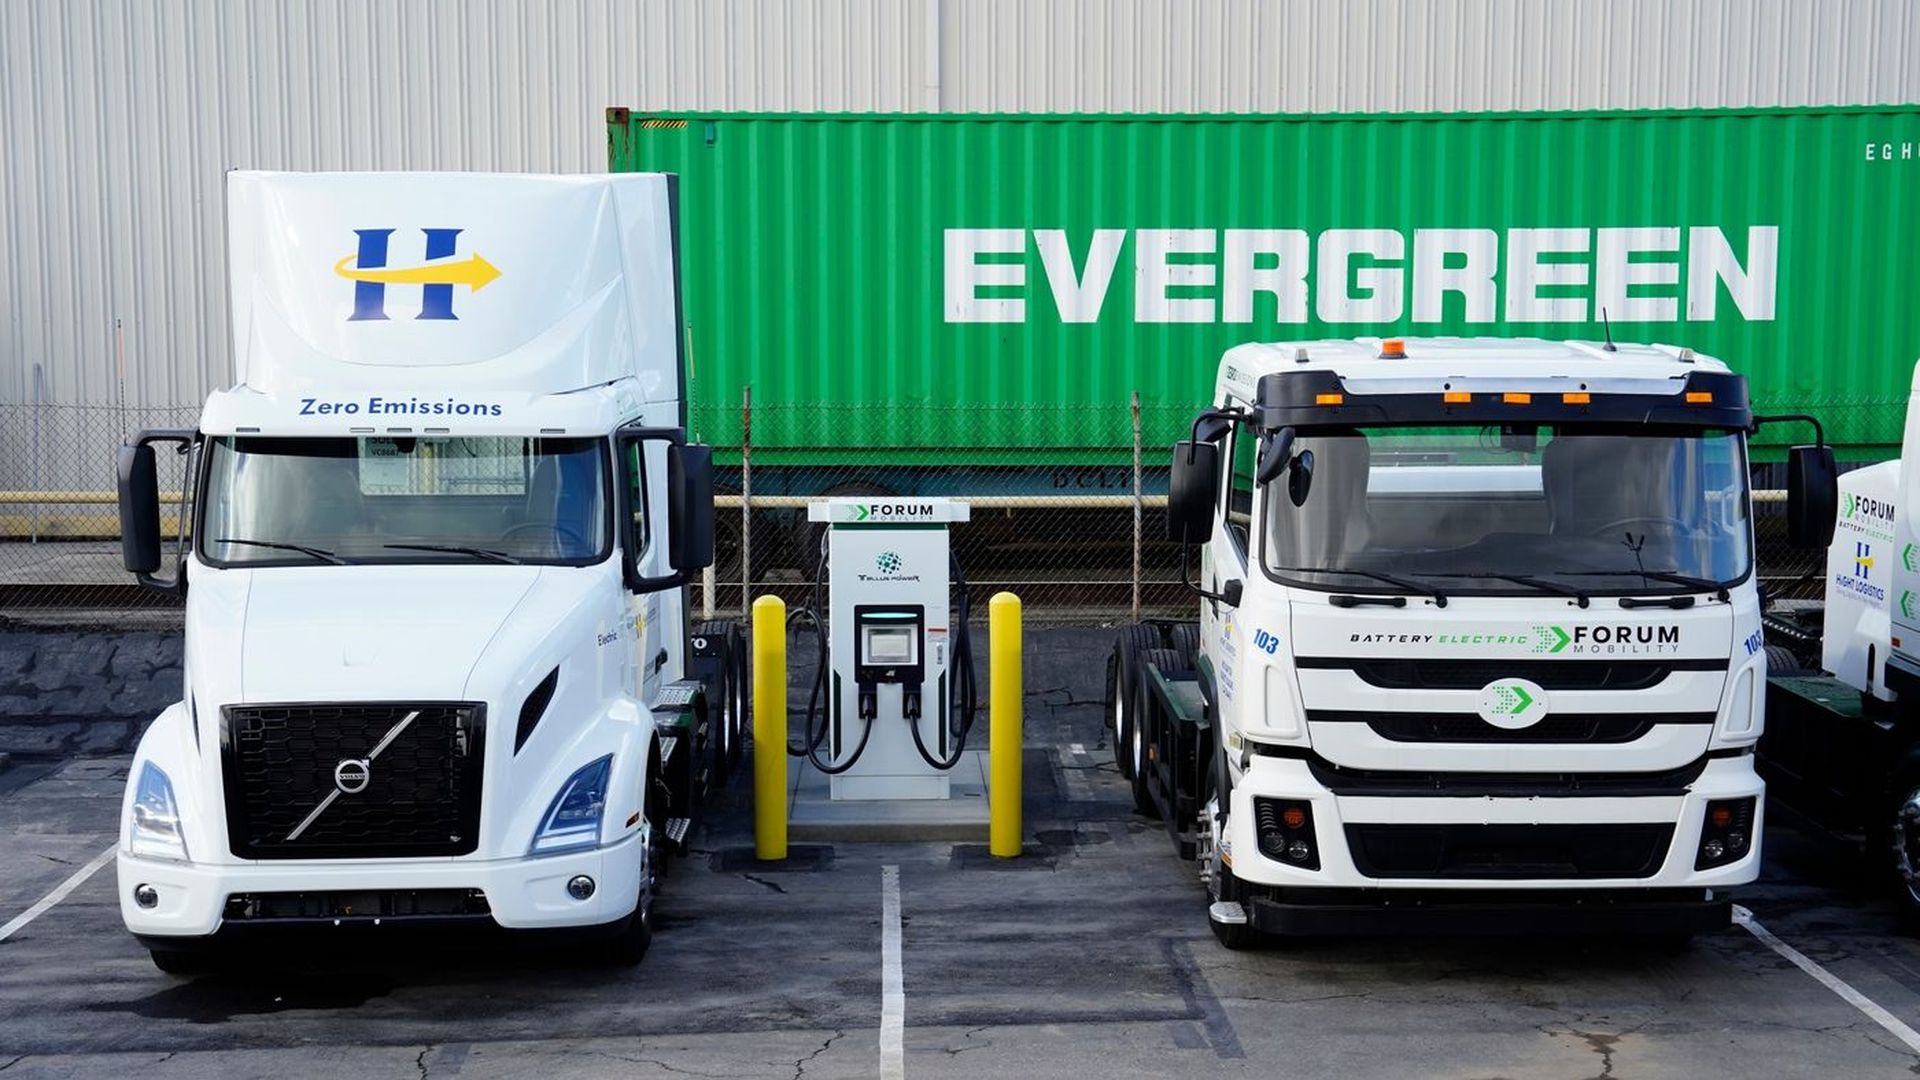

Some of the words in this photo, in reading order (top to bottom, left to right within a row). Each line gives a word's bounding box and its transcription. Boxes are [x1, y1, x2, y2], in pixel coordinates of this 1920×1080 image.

[1865, 143, 1920, 160] EGH
[943, 225, 1779, 325] EVERGREEN
[299, 398, 360, 416] Zero
[368, 397, 503, 417] Emissions
[870, 504, 934, 516] FORUM
[1855, 495, 1895, 522] FORUM
[597, 631, 618, 647] Electric
[1253, 628, 1280, 655] 103
[1349, 633, 1433, 643] BATTERY
[1438, 634, 1528, 645] ELECTRIC
[1574, 625, 1680, 644] FORUM
[1743, 629, 1762, 655] 103
[1573, 644, 1679, 654] MOBILITY
